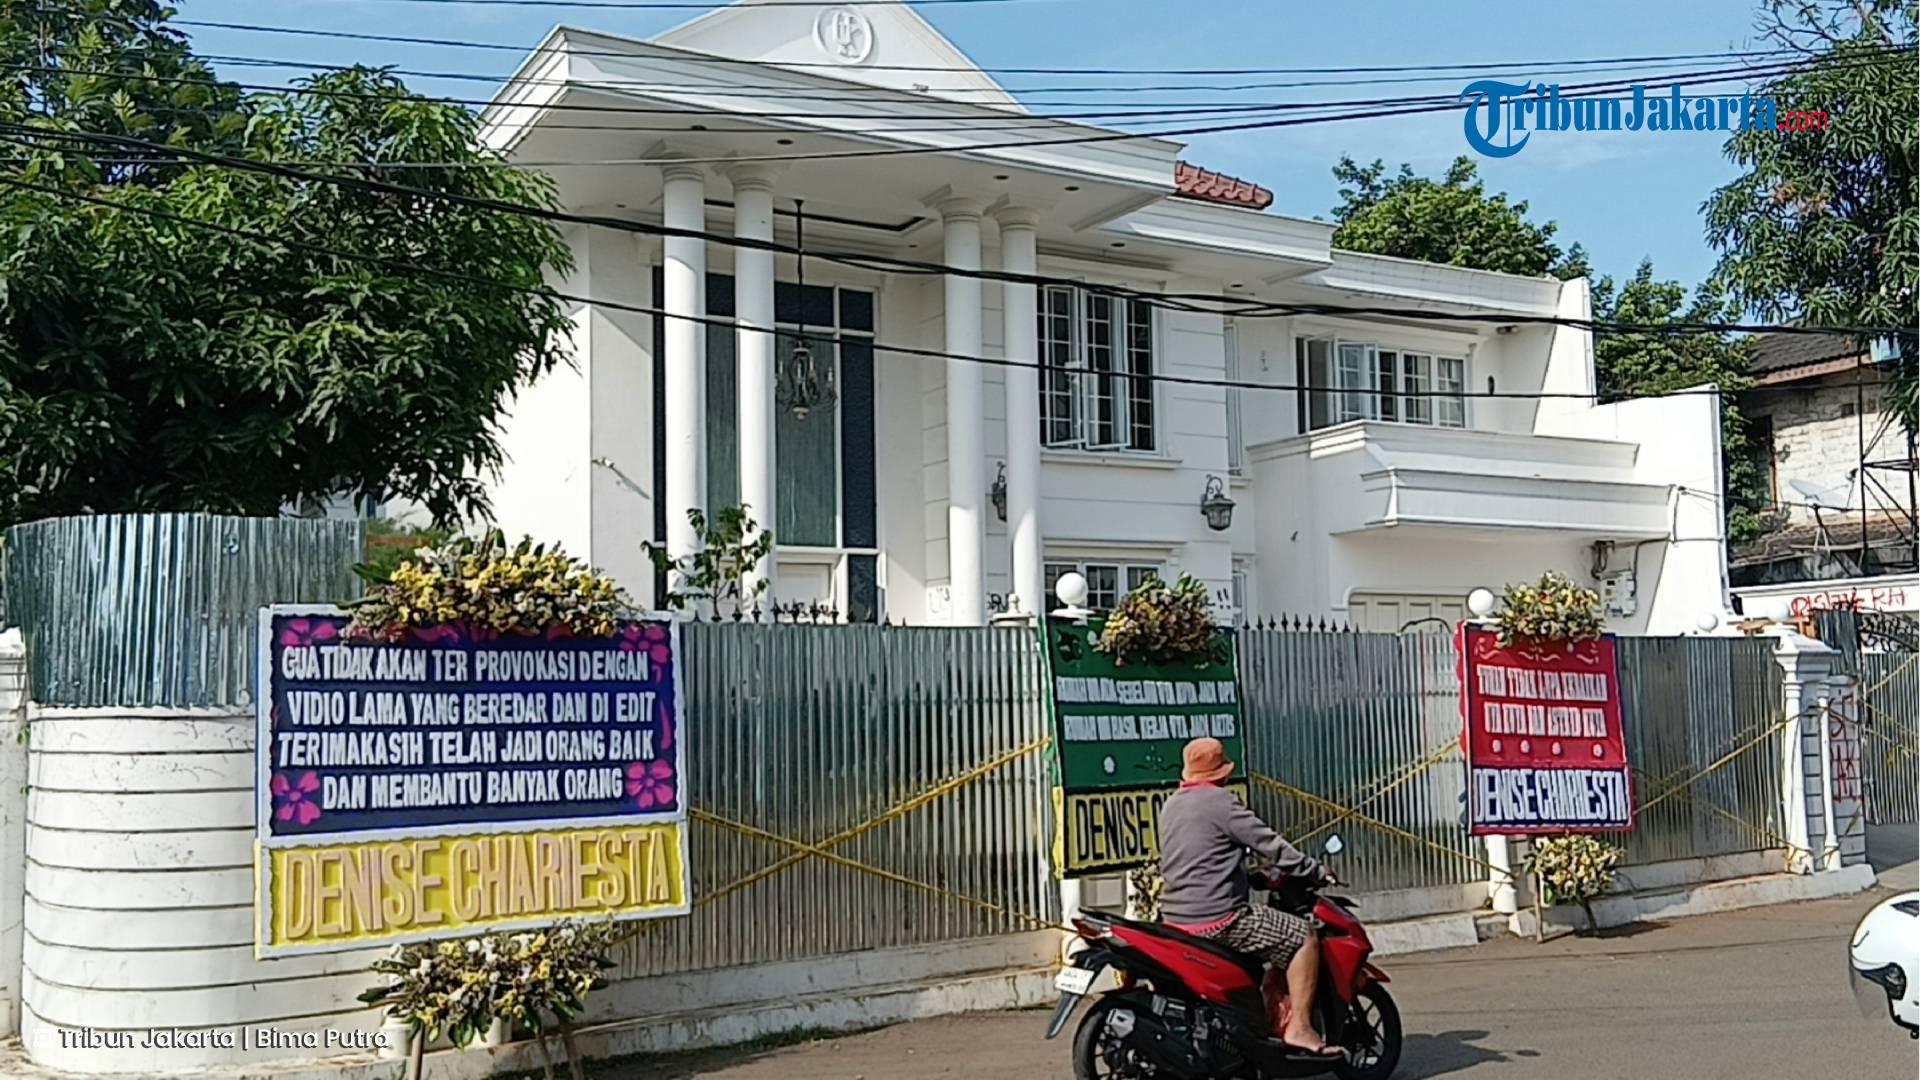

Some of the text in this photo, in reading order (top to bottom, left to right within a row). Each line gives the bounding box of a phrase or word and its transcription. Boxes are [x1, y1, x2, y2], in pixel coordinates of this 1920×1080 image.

[282, 646, 649, 681] GUA TIDAK AKAN TER PROVOKASI DENGAN
[287, 691, 656, 725] VIDIO LAMA YANG BEREDAR DAN DI EDIT
[278, 729, 655, 767] TERIMAKASIH TELAH JADI ORANG BAIK
[323, 767, 623, 810] DAN MEMBANTU BANYAK ORANG
[1075, 794, 1150, 861] DENISE
[284, 828, 671, 940] DENISE CHARIESTA
